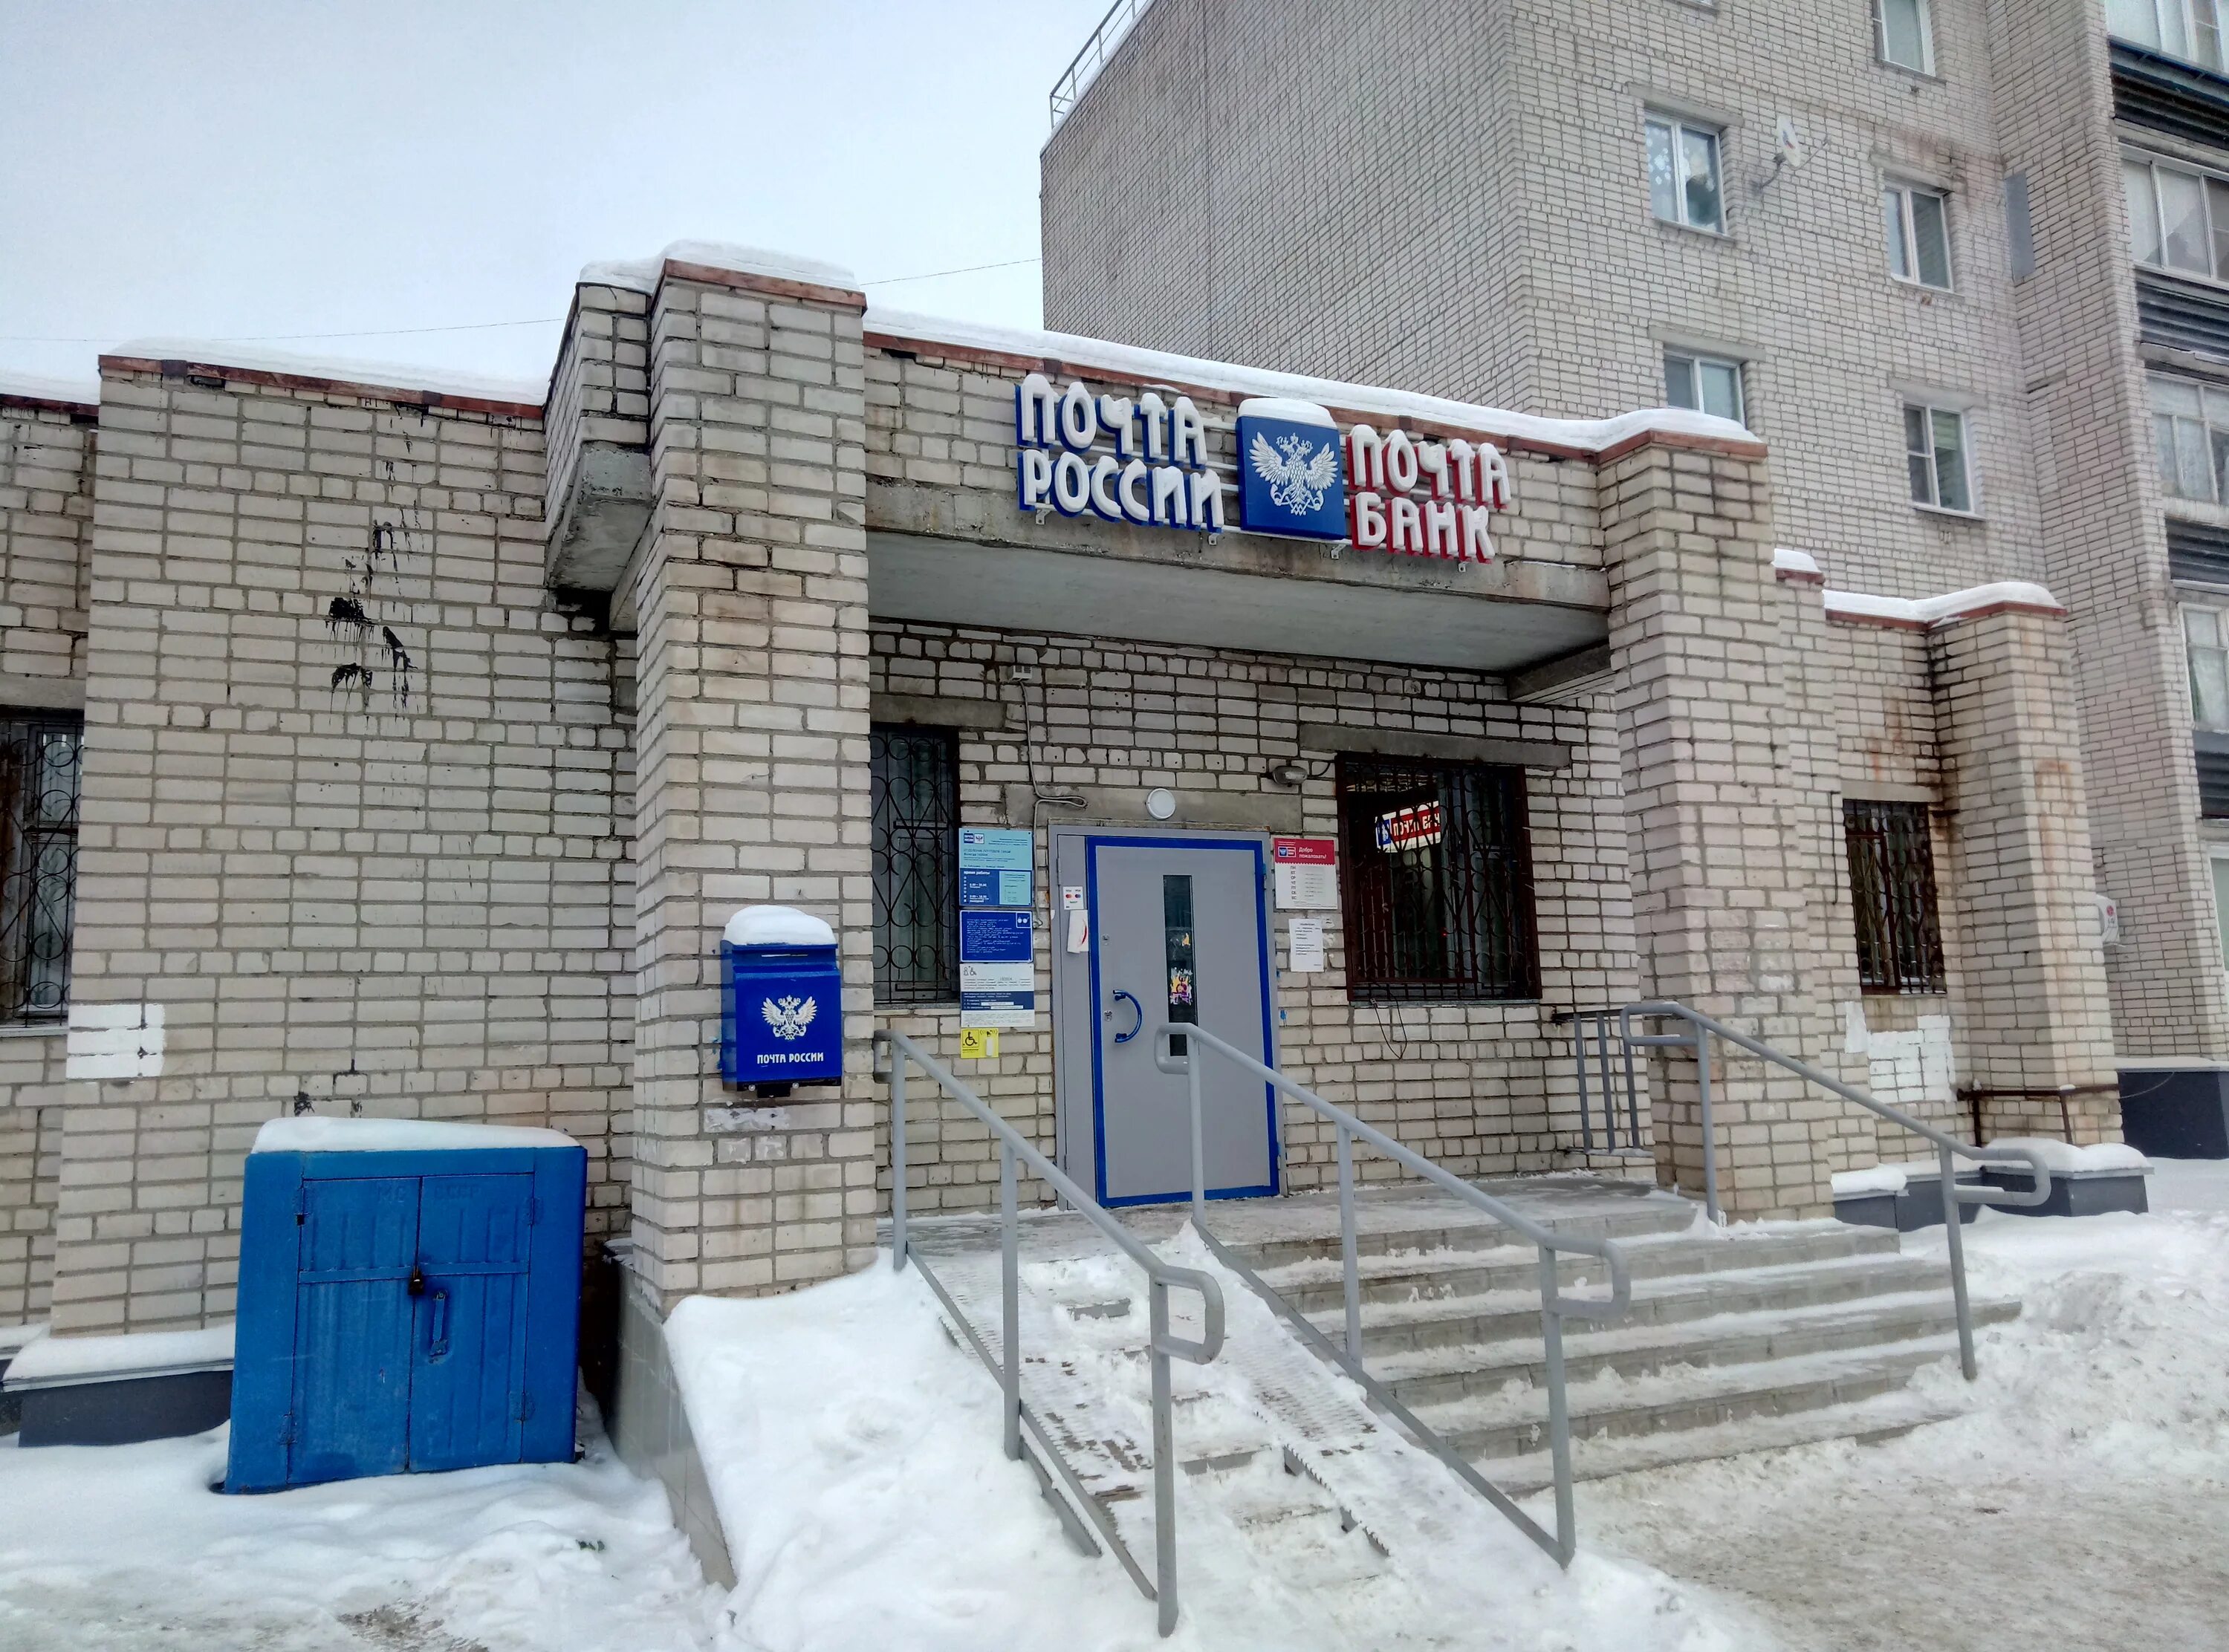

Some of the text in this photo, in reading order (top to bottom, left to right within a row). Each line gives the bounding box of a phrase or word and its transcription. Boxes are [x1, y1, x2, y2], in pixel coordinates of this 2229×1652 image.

[1016, 377, 1209, 469] ПОЧТА
[1017, 449, 1224, 533] РОССИИ
[1346, 427, 1511, 510] ПОЧТА
[1349, 491, 1495, 565] БАНК
[756, 1052, 824, 1064] ПОЧТА РОССИИ
